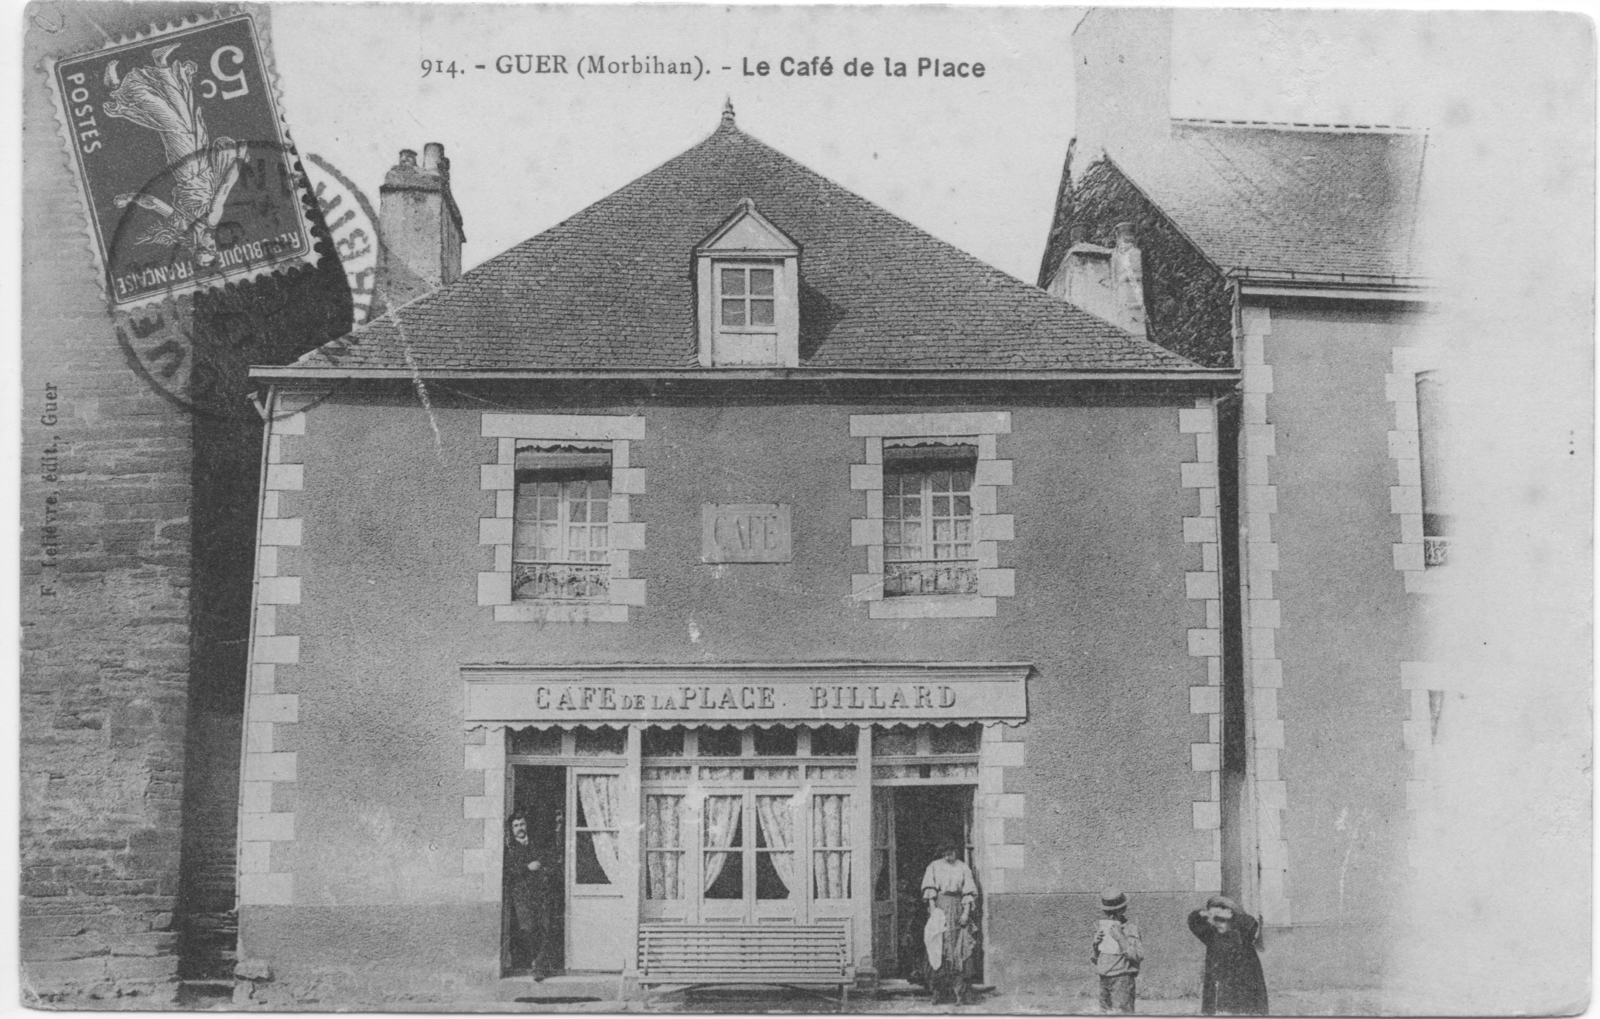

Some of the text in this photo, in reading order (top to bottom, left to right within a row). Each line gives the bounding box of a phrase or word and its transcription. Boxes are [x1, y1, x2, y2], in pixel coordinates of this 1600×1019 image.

[66, 71, 103, 154] POSTES
[620, 694, 646, 711] DE
[651, 694, 677, 711] LA
[808, 685, 957, 710] BILLARD
